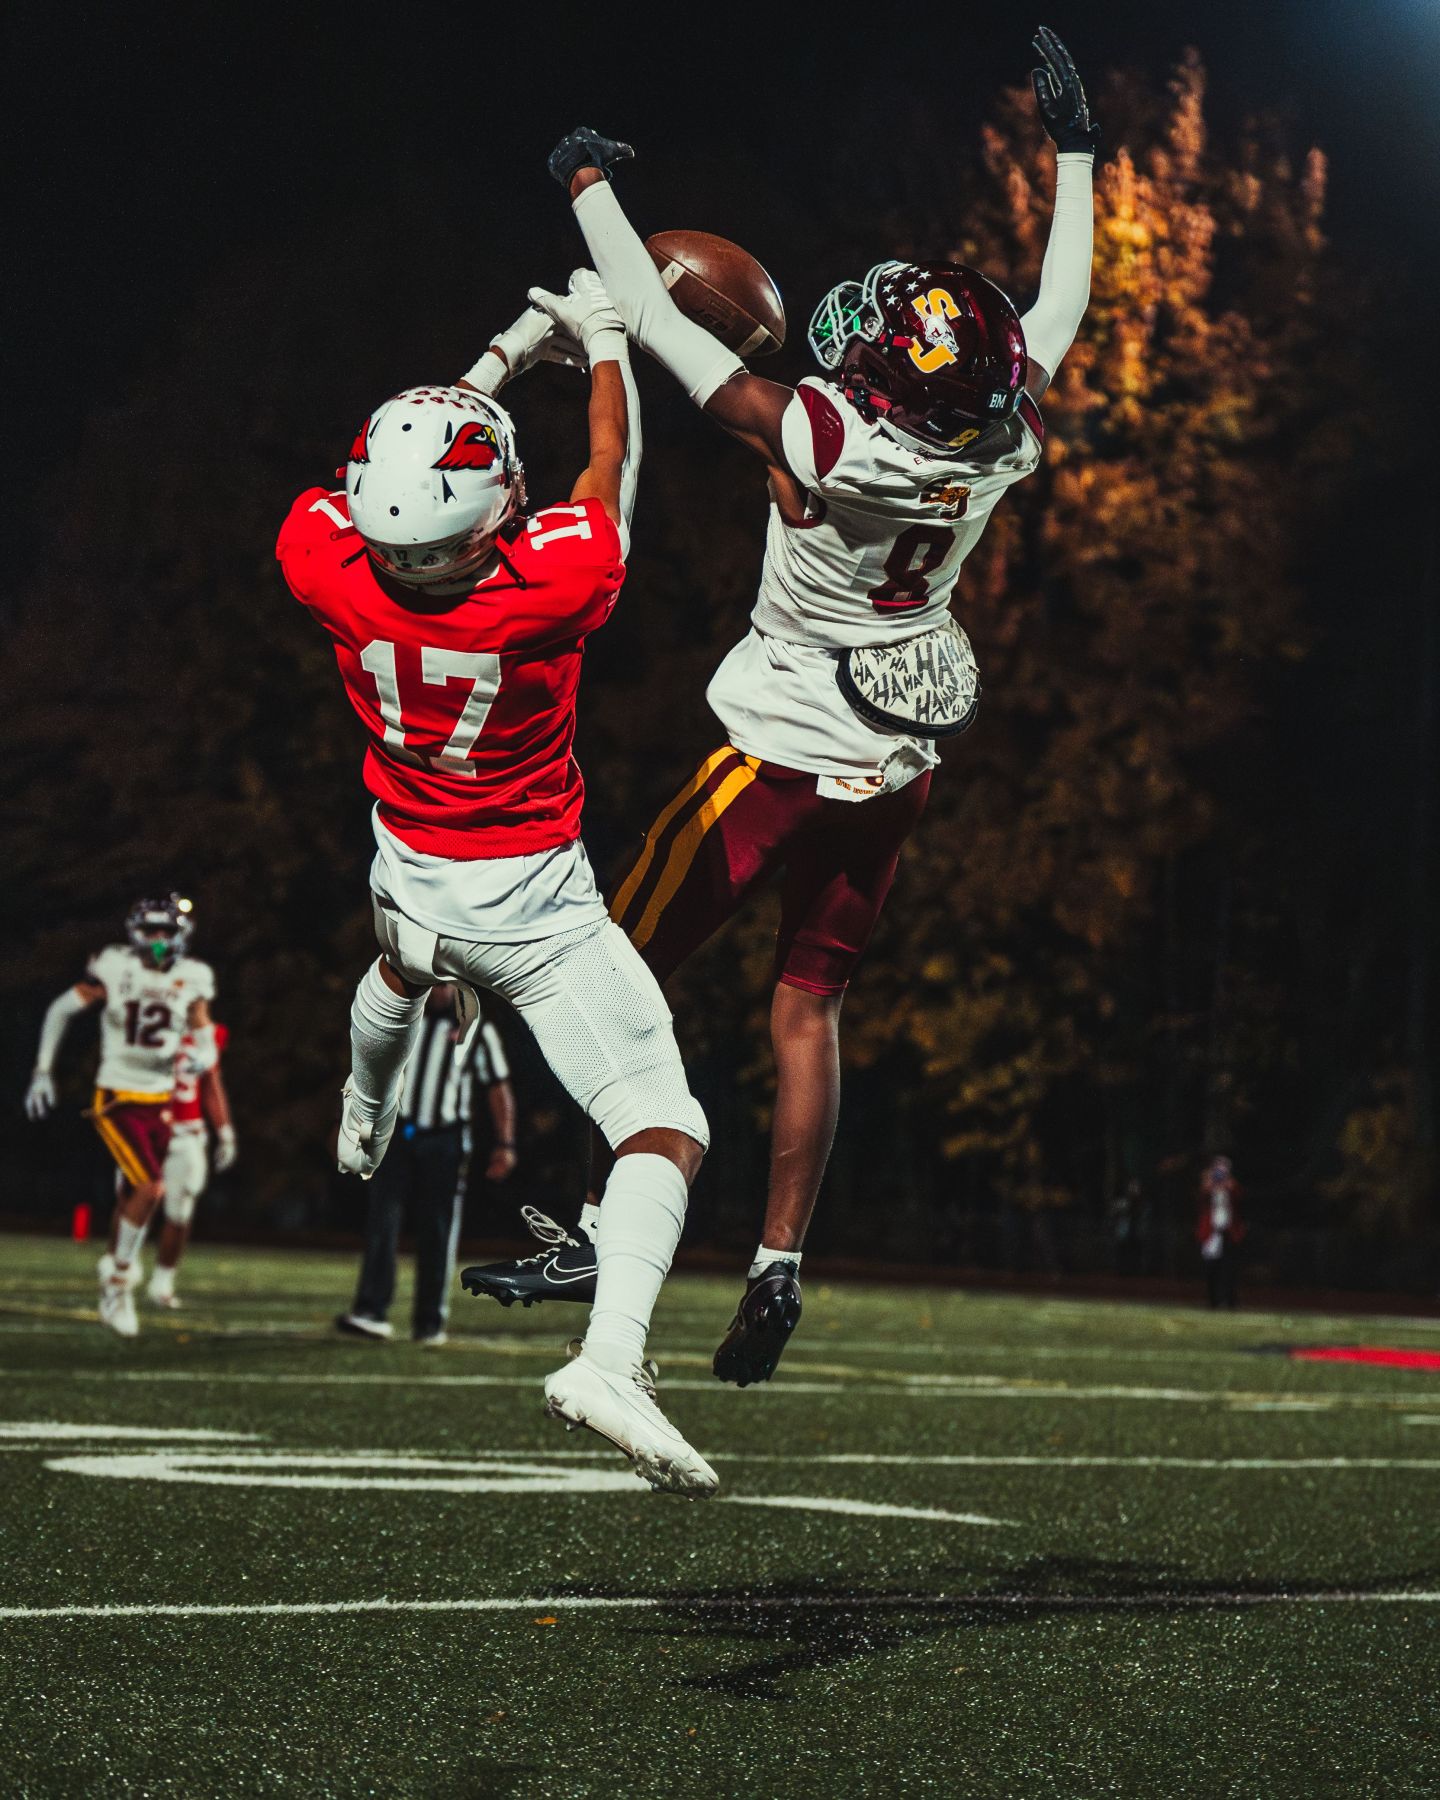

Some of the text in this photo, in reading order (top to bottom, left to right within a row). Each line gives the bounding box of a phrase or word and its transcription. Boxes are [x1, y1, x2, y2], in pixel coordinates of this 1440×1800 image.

[989, 393, 1008, 409] BM
[867, 524, 956, 615] 8
[854, 662, 876, 687] HA
[889, 656, 909, 674] HA
[915, 641, 959, 689] HA
[873, 672, 909, 708] HA
[903, 673, 924, 693] HA
[360, 639, 502, 779] 17
[915, 689, 949, 723] HA
[124, 1000, 173, 1049] 12
